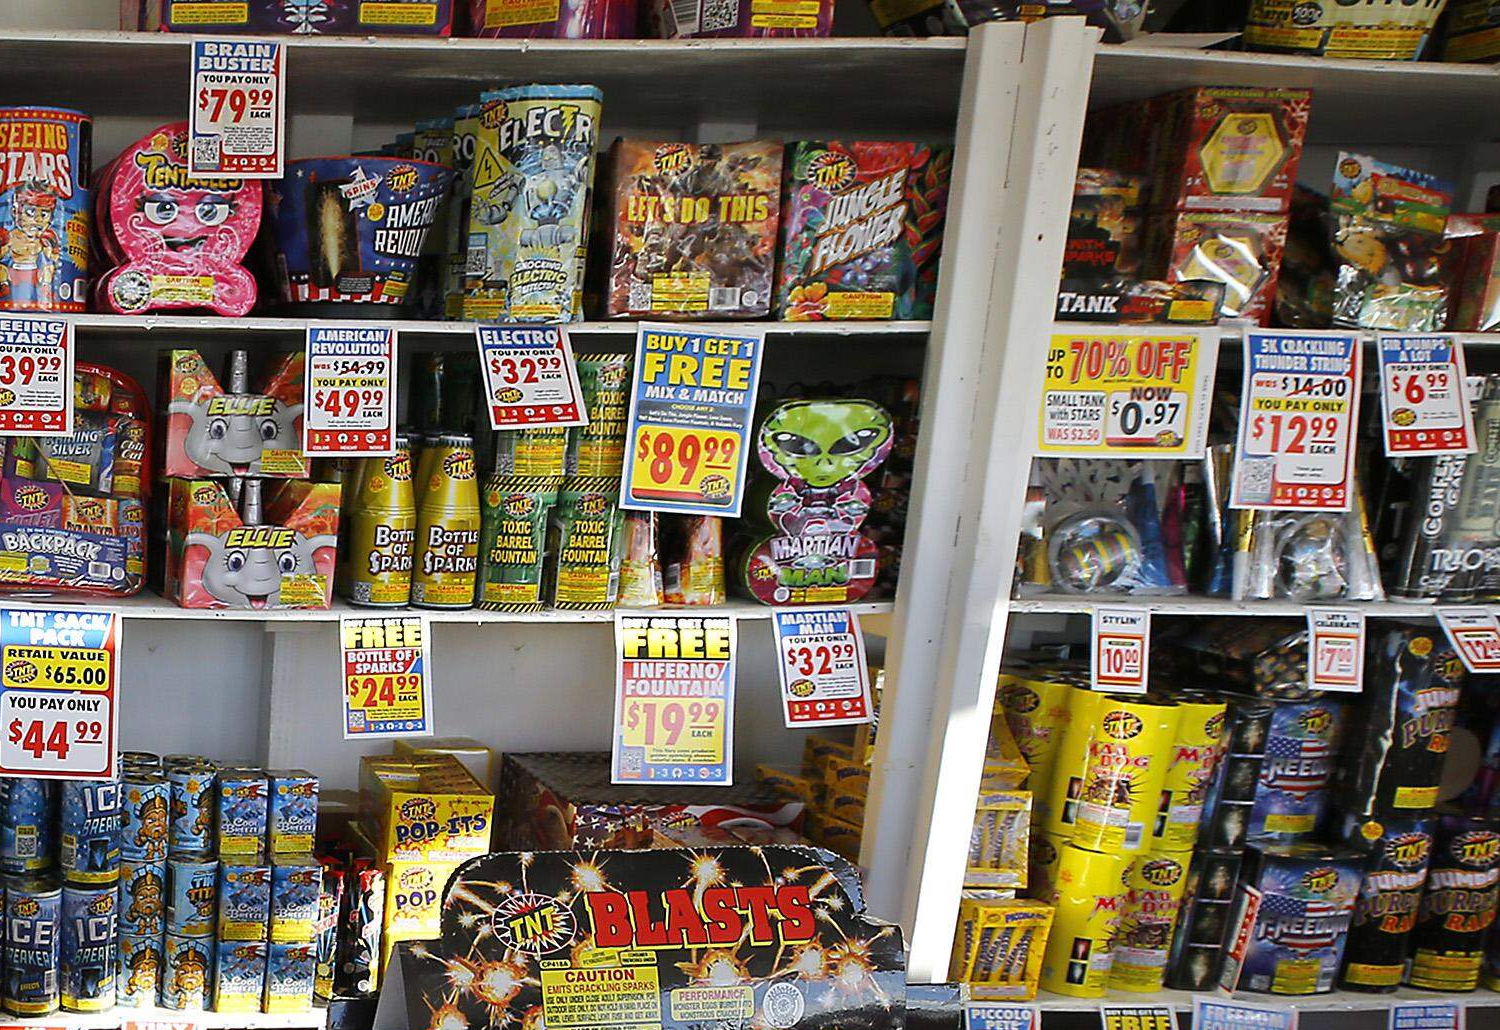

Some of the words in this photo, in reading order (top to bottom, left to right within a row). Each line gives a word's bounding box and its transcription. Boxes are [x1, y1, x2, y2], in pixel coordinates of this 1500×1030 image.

[204, 43, 270, 57] BRAIN
[199, 57, 275, 71] BUSTER
[345, 180, 377, 198] SPINS
[628, 194, 675, 223] LET'S
[677, 195, 712, 223] DO
[718, 194, 769, 223] THIS
[821, 168, 908, 233] JUNGLE
[813, 203, 908, 275] FLOWER
[1058, 293, 1120, 314] TANK
[316, 330, 384, 342] AMERICAN
[481, 330, 559, 345] ELECTRO
[311, 343, 389, 355] REVOLUTION
[646, 334, 688, 351] BUY
[691, 338, 701, 353] 1
[704, 338, 742, 356] GET
[744, 342, 755, 357] 1
[1048, 349, 1065, 362] UP
[1070, 340, 1131, 384] 70%
[1255, 354, 1307, 371] THUNDER
[643, 352, 753, 390] FREE
[1046, 366, 1063, 379] TO
[645, 386, 675, 399] MIX
[678, 388, 690, 400] &
[693, 390, 744, 404] MATCH
[1047, 394, 1077, 407] SMALL
[1131, 387, 1172, 401] NOW
[207, 396, 275, 417] ELLIE
[1050, 409, 1069, 420] with
[502, 521, 532, 534] TOXIC
[575, 521, 605, 534] TOXIC
[3, 532, 99, 560] BACKPACK
[225, 528, 295, 549] ELLIE
[496, 535, 533, 548] BARREL
[569, 535, 606, 548] BARREL
[770, 535, 861, 560] MARTIAN
[490, 550, 537, 564] FOUNTAIN
[53, 613, 107, 631] SACK
[782, 613, 848, 624] MARTIAN
[29, 629, 85, 647] PACK
[345, 626, 422, 648] FREE
[623, 628, 730, 659] FREE
[8, 649, 54, 659] RETAIL
[60, 651, 105, 661] VALUE
[347, 651, 392, 663] BOTTLE
[45, 665, 106, 685] $65.00
[355, 662, 405, 674] SPARKS
[632, 662, 719, 679] INFERNO
[626, 679, 725, 696] FOUNTAIN
[9, 697, 37, 709] YOU
[40, 698, 64, 711] PAY
[67, 700, 100, 712] ONLY
[395, 813, 487, 843] POP-ITS
[586, 885, 816, 950] BLASTS
[564, 970, 635, 983] CAUTION
[970, 1008, 1032, 1021] PICCOLO
[986, 1019, 1020, 1030] PETE
